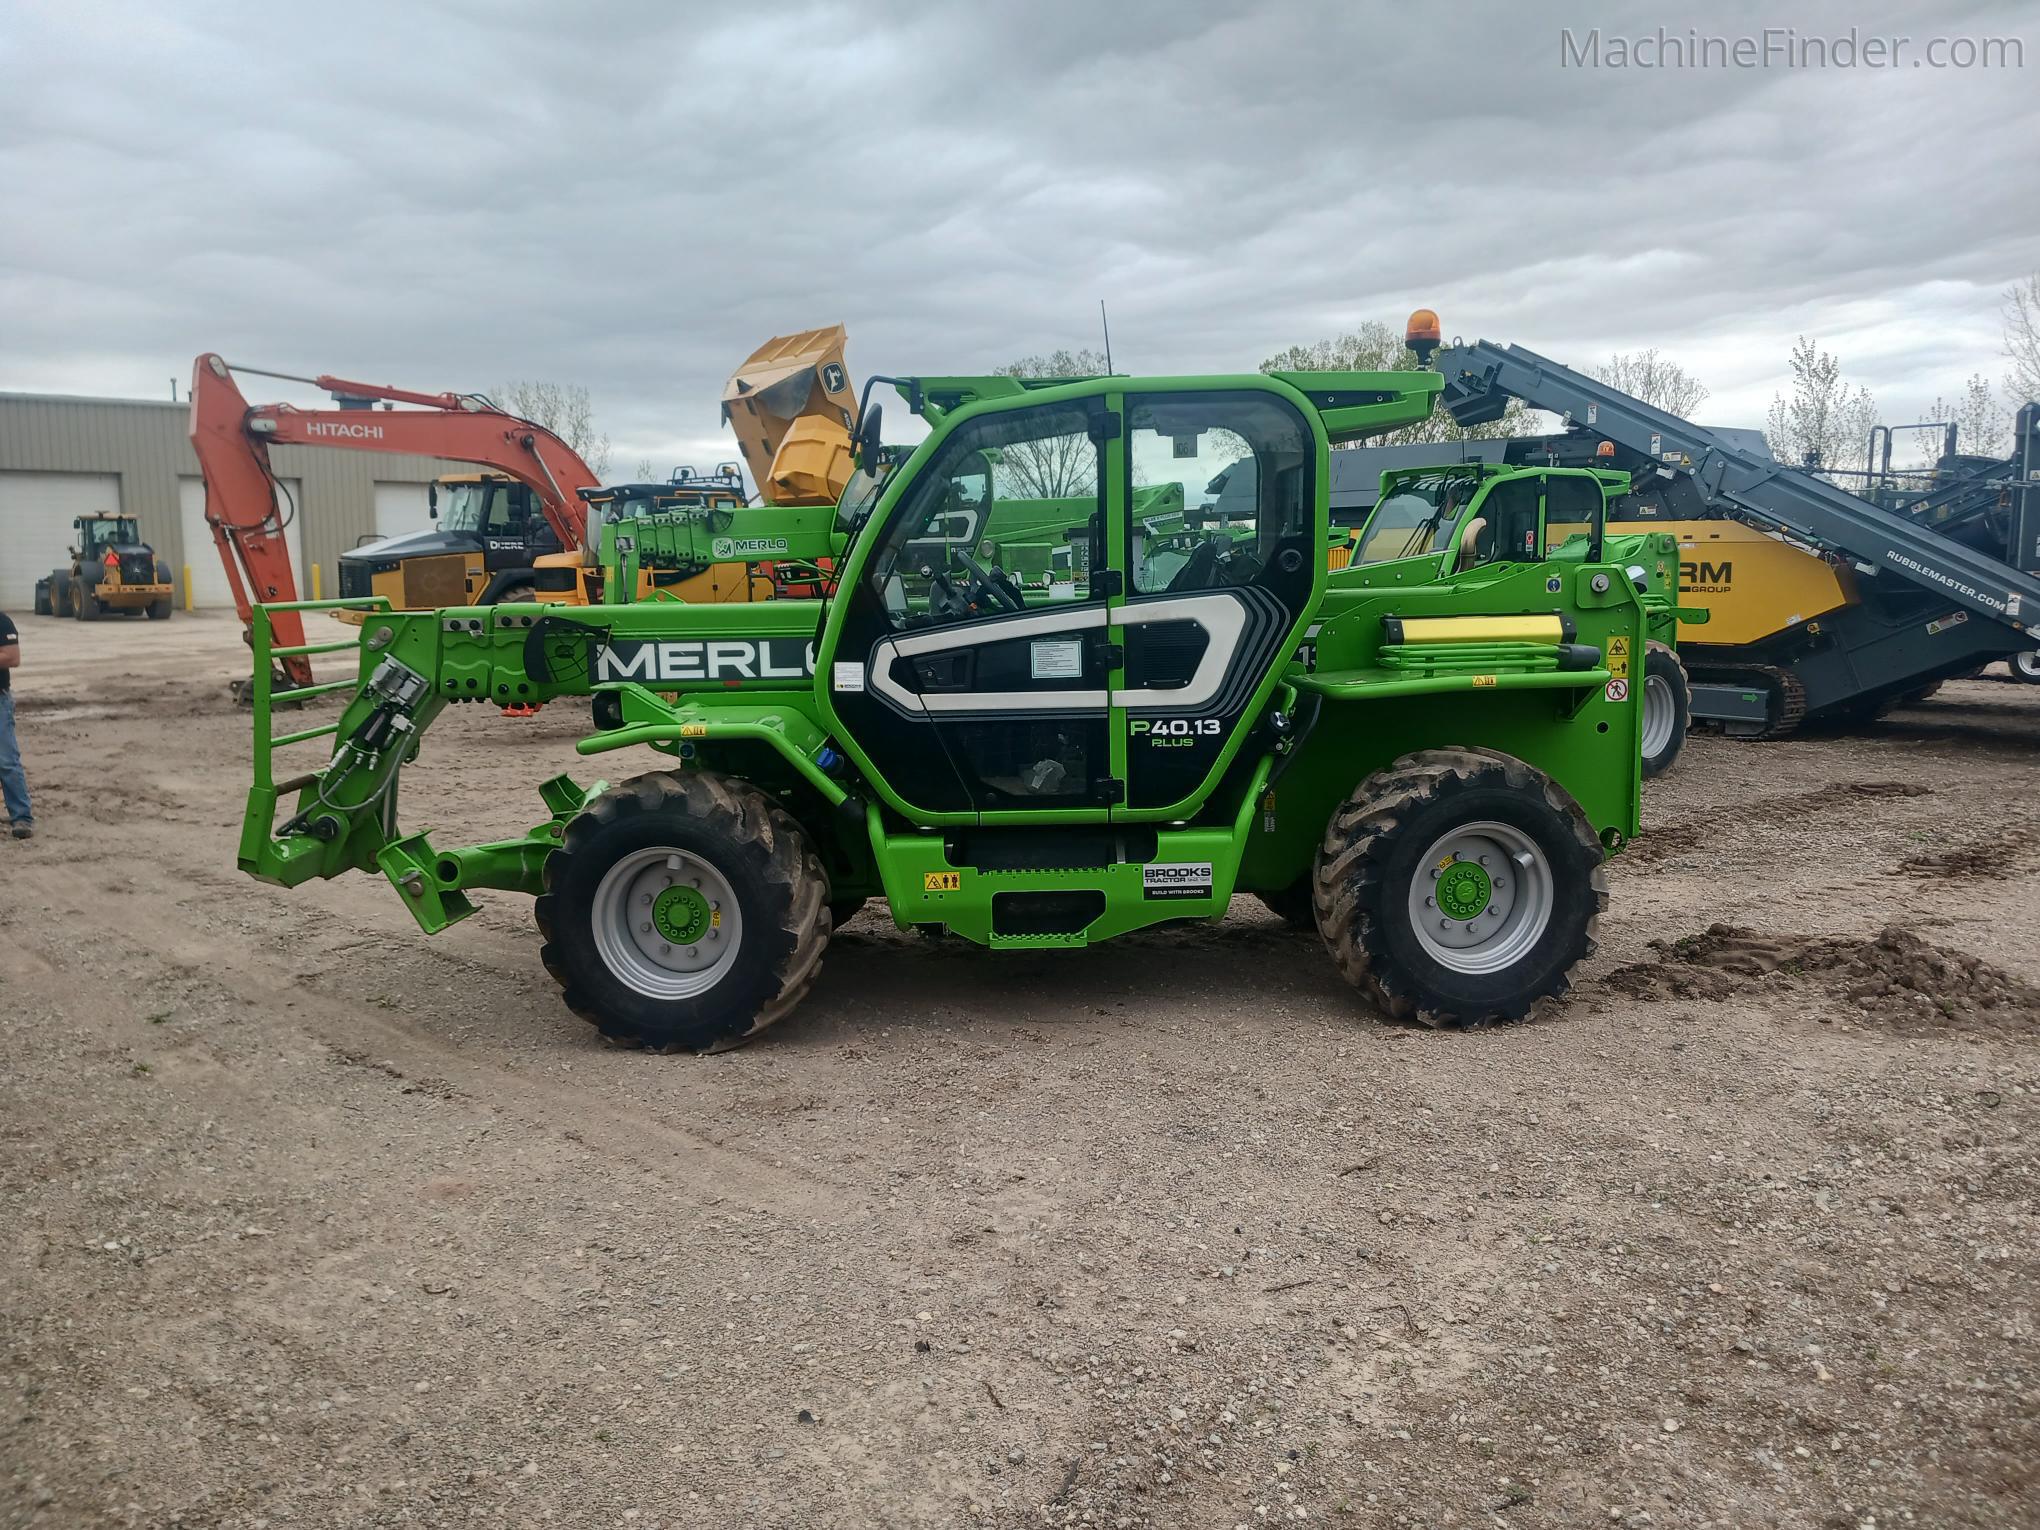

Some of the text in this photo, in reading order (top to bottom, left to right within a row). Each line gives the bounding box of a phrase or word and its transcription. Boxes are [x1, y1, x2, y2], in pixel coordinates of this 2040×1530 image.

[306, 422, 384, 439] HITACHI
[735, 539, 787, 550] MERLO
[1886, 550, 2007, 612] RUBBLEMASTER.COM
[596, 641, 817, 681] MERL
[1151, 738, 1194, 747] PLUS
[1144, 867, 1211, 878] BROOKS
